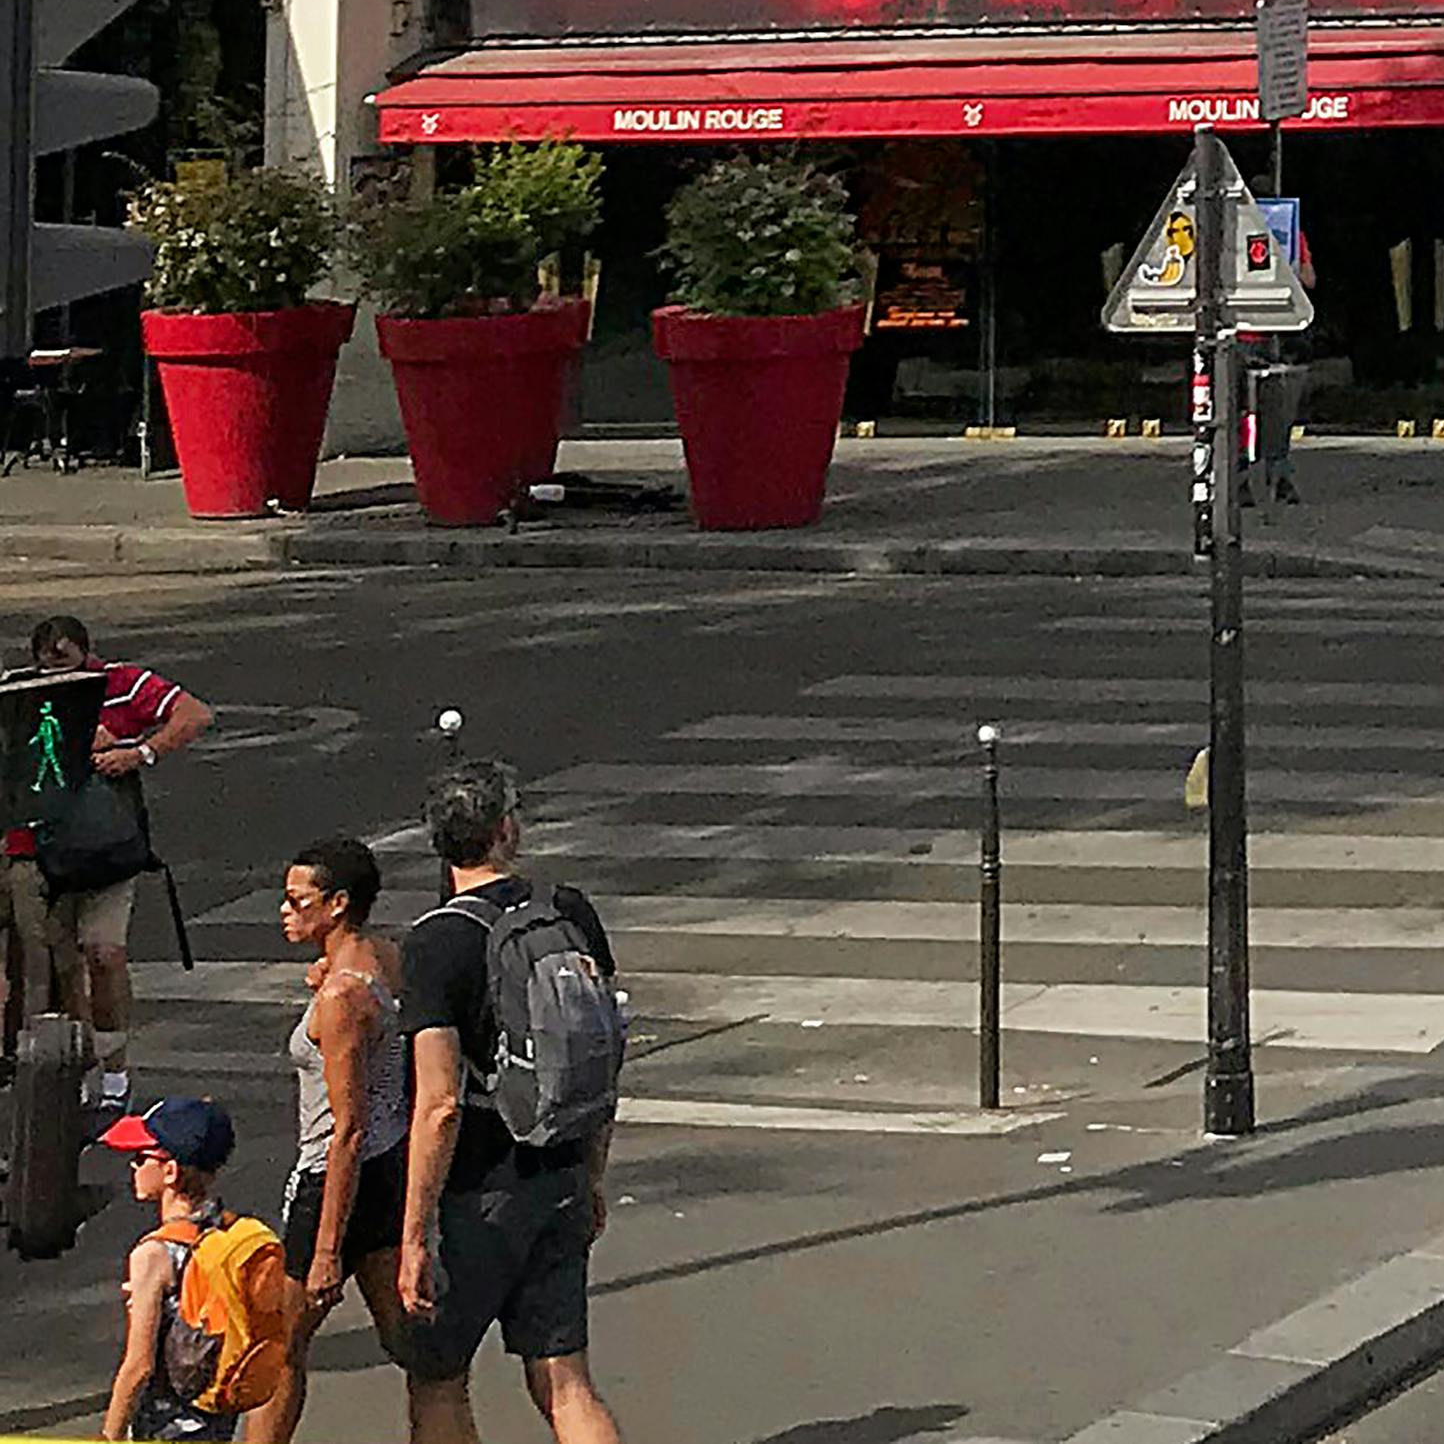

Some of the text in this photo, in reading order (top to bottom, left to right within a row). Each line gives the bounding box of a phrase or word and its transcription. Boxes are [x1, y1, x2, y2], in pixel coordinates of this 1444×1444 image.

[613, 107, 783, 131] MOULIN ROUGE
[1169, 99, 1260, 121] MOULIN
